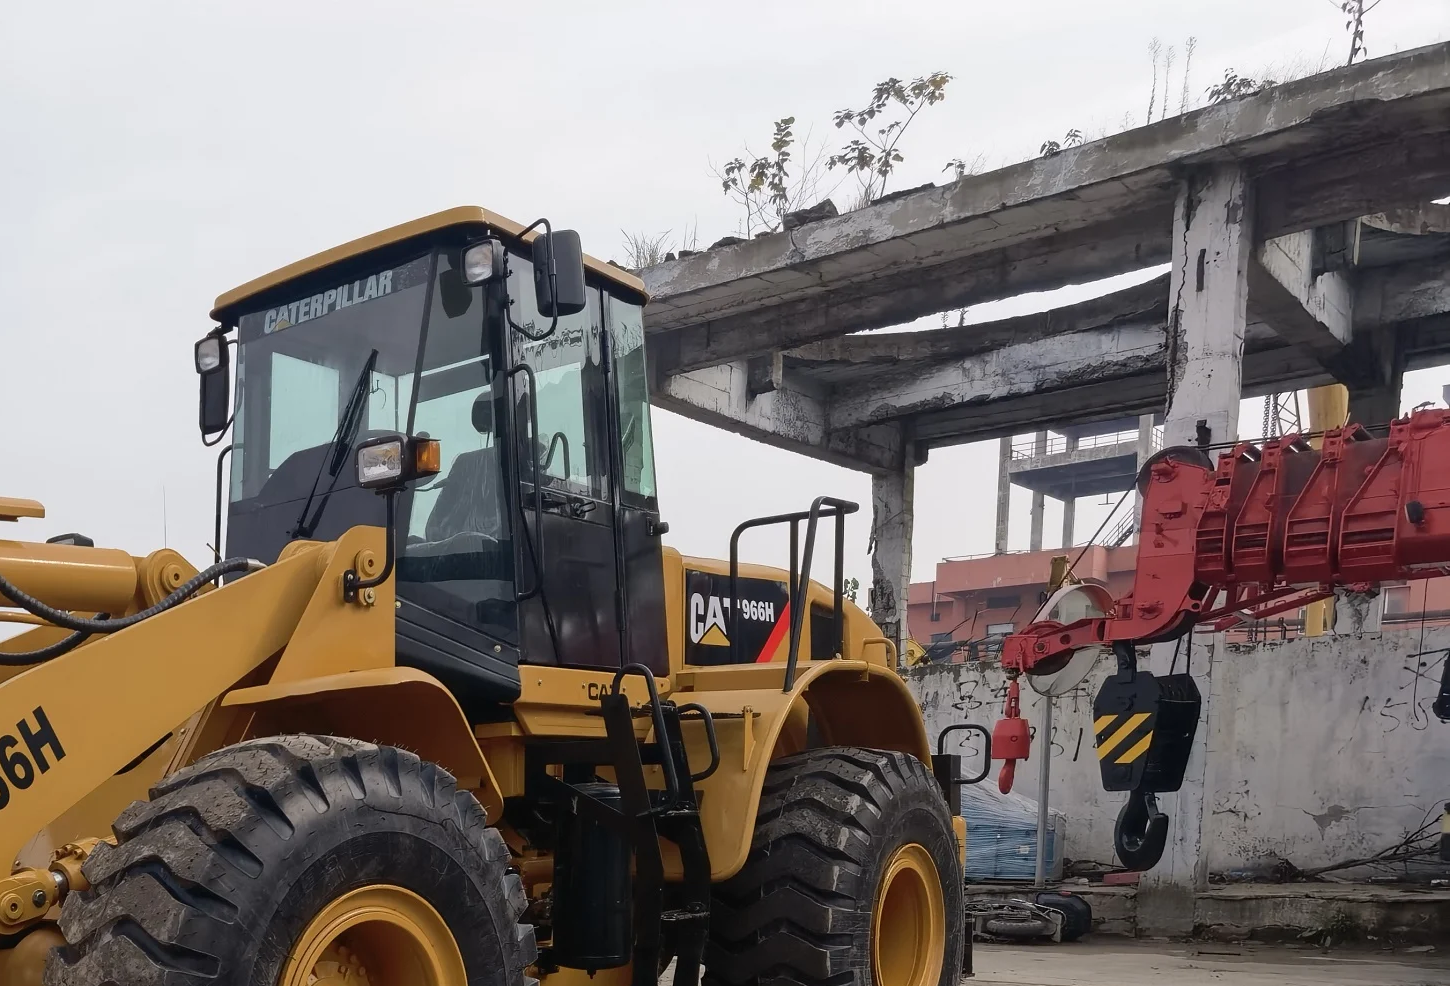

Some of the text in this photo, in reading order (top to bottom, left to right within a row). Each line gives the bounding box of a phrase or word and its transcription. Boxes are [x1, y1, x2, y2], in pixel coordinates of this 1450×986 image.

[264, 270, 393, 334] CATERPILLAR
[742, 599, 775, 622] 966H
[588, 683, 612, 700] CA
